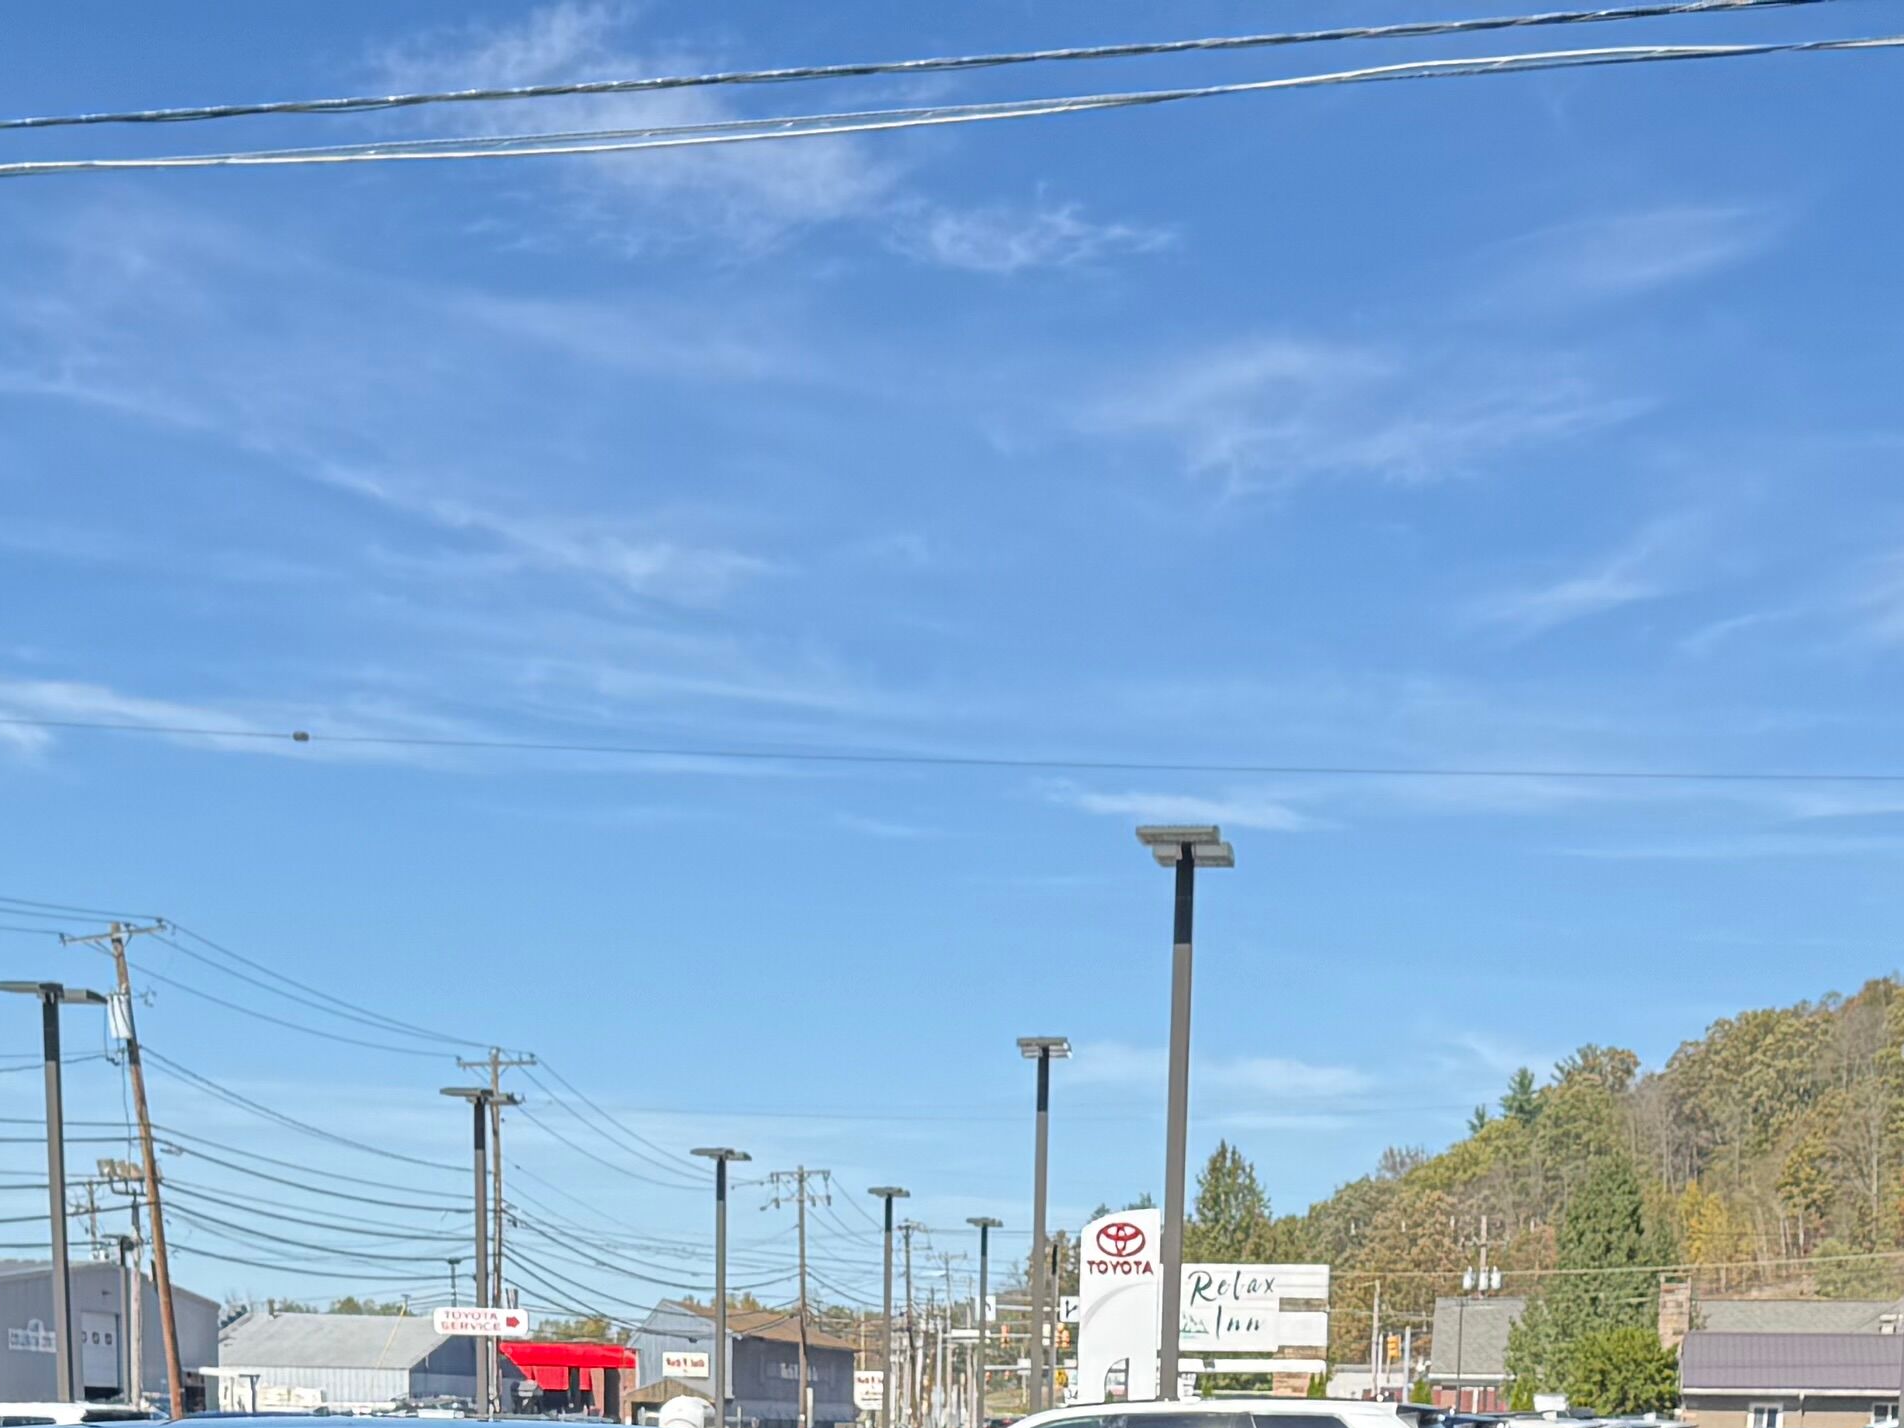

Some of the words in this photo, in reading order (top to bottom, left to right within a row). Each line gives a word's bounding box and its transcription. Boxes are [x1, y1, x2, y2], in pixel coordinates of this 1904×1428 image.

[1086, 1260, 1154, 1275] TOYOTA
[1187, 1270, 1276, 1306] Relax
[444, 1310, 498, 1321] TOYOTA
[1216, 1305, 1260, 1340] Inn
[440, 1321, 501, 1331] SERVICE
